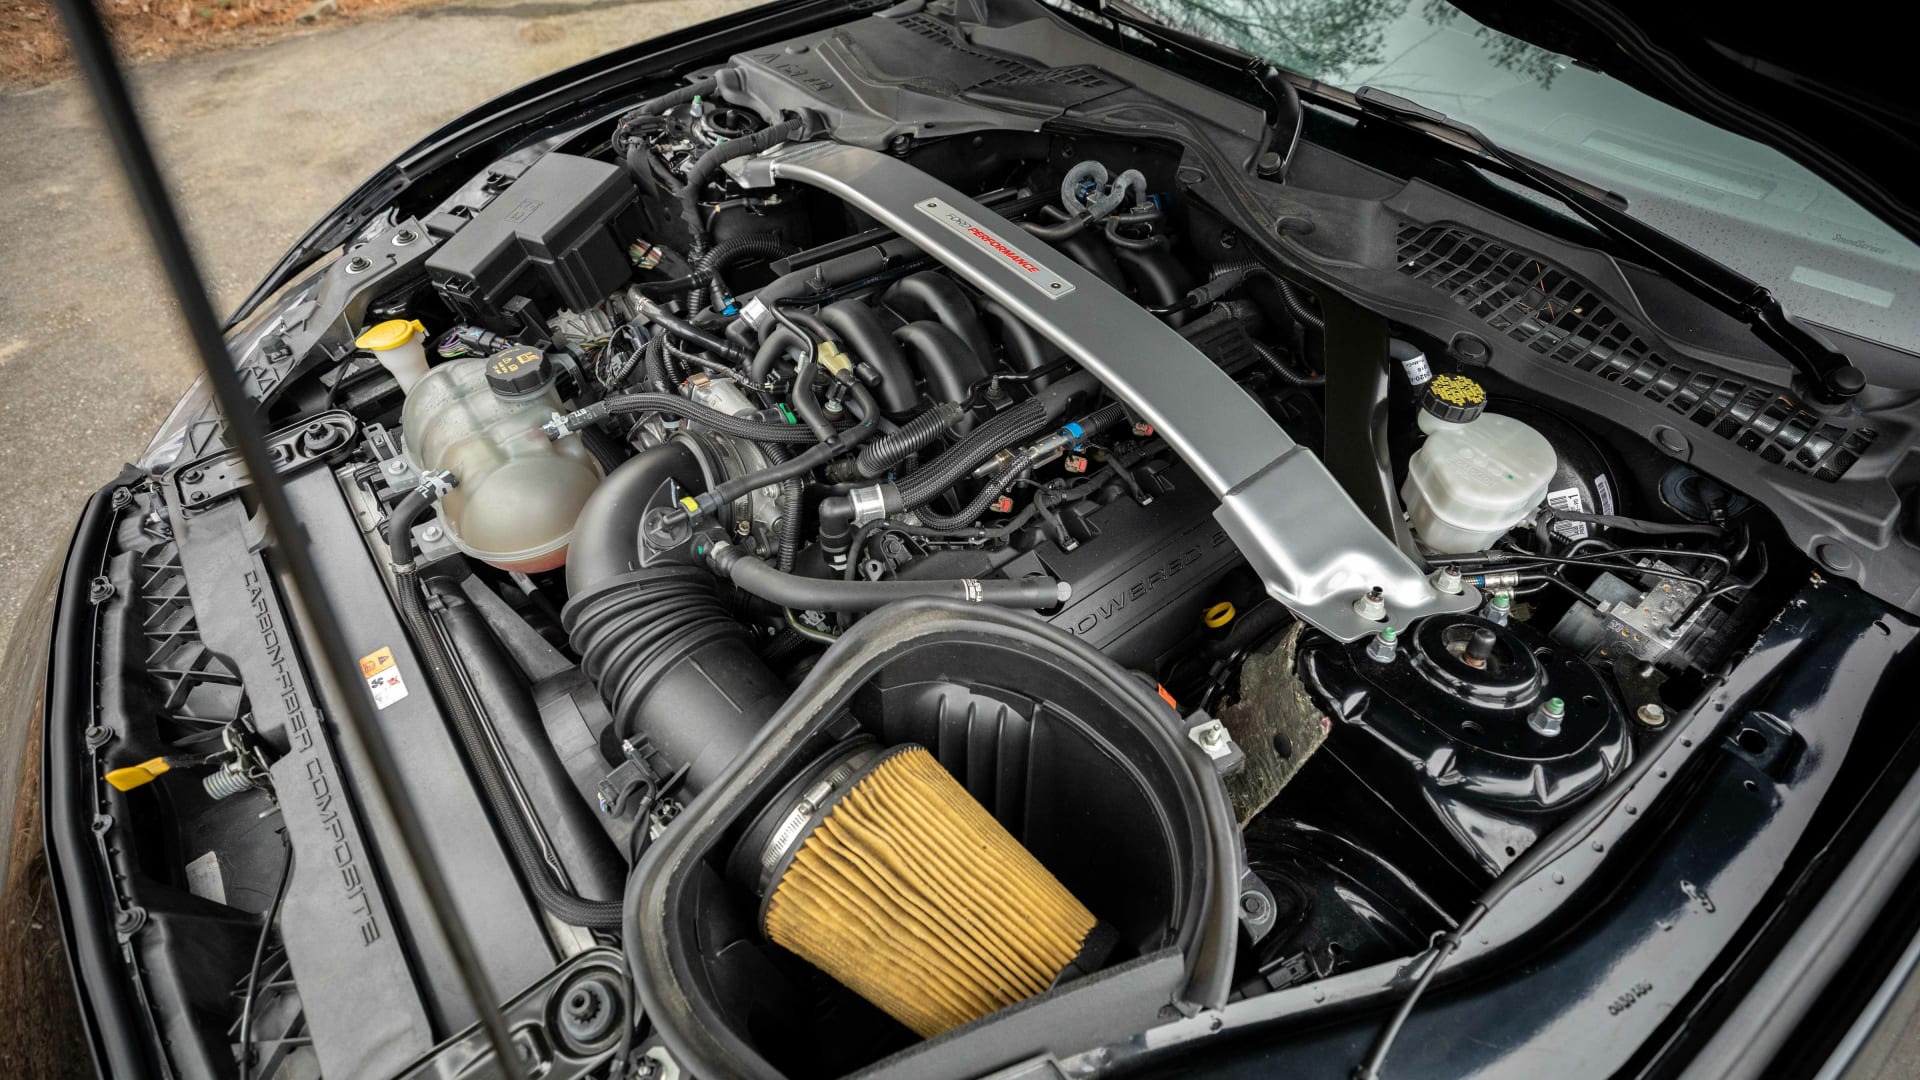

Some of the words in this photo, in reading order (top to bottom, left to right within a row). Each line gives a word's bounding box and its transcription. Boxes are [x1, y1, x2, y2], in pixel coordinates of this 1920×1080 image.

[946, 213, 972, 229] FORD
[967, 226, 1041, 273] PERFORMANCE
[244, 570, 313, 753] CARBON-FIBER
[307, 757, 381, 947] COMPOSITE
